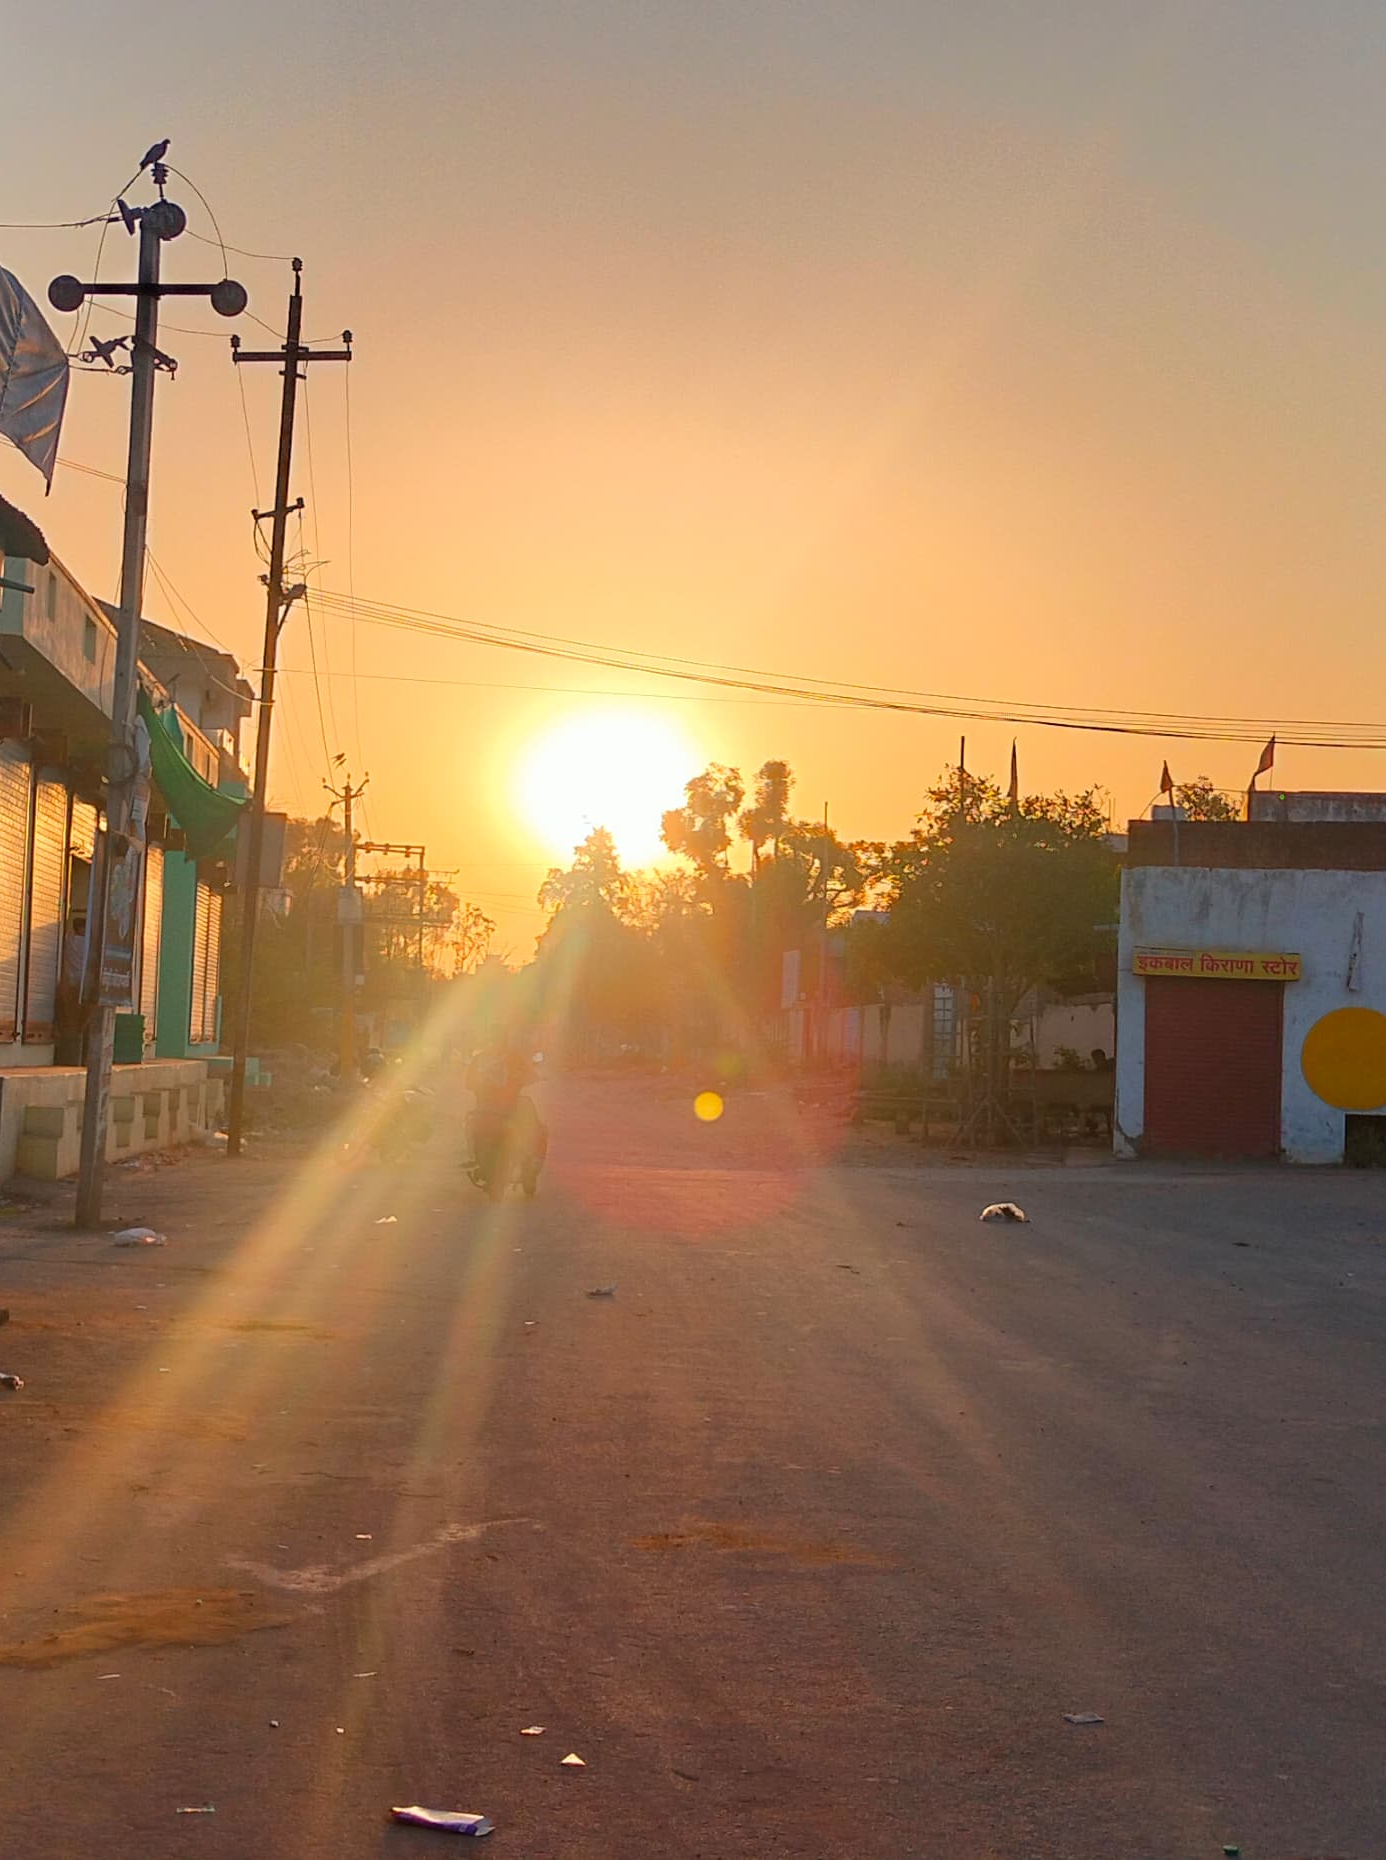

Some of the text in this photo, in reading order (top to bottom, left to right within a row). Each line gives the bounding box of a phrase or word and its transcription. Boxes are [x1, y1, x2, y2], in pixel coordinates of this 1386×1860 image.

[1136, 953, 1300, 976] इकबाल किराणा स्टोर
